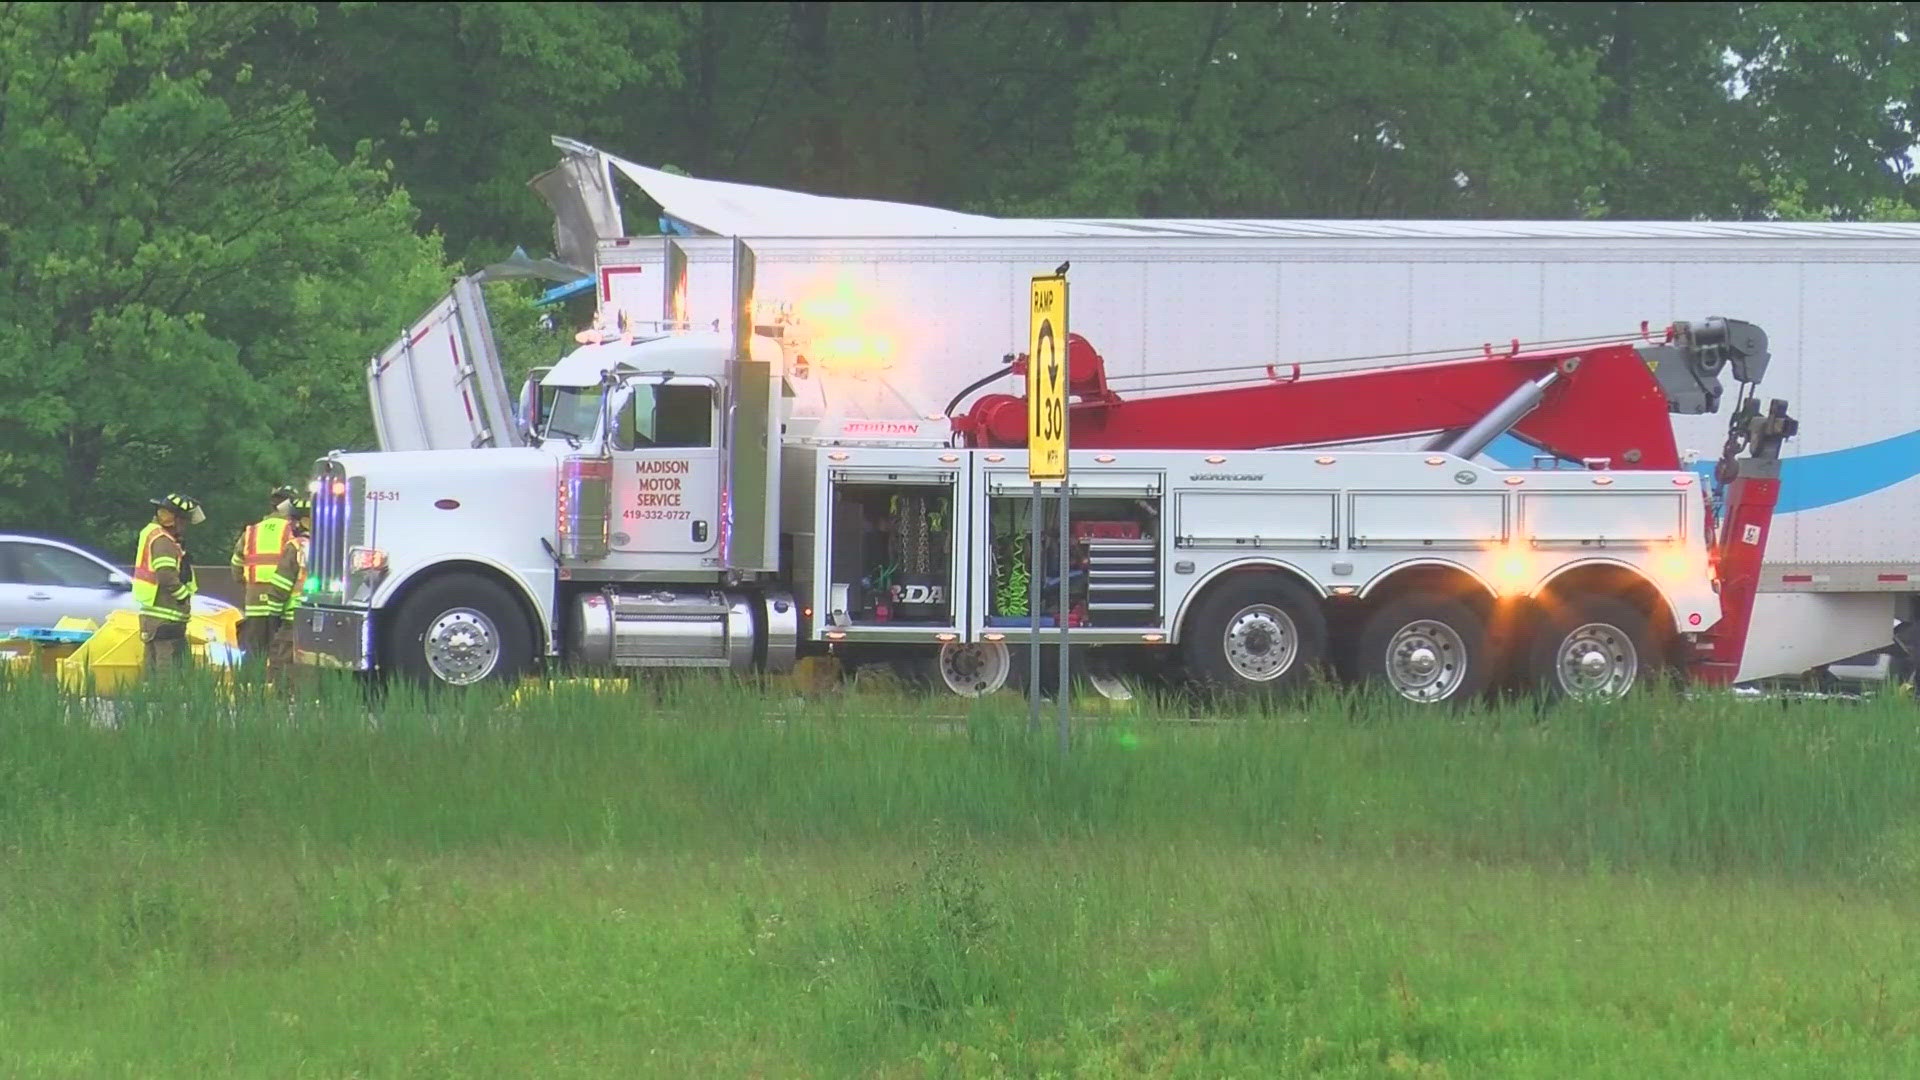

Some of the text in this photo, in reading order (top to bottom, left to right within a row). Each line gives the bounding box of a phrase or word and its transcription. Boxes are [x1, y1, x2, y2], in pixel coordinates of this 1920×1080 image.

[1033, 290, 1054, 313] RAMP
[1044, 397, 1062, 441] 30
[636, 461, 689, 474] MADISON
[639, 478, 681, 491] MOTOR
[637, 493, 681, 507] SERVICE
[623, 510, 691, 520] 419-332-0727
